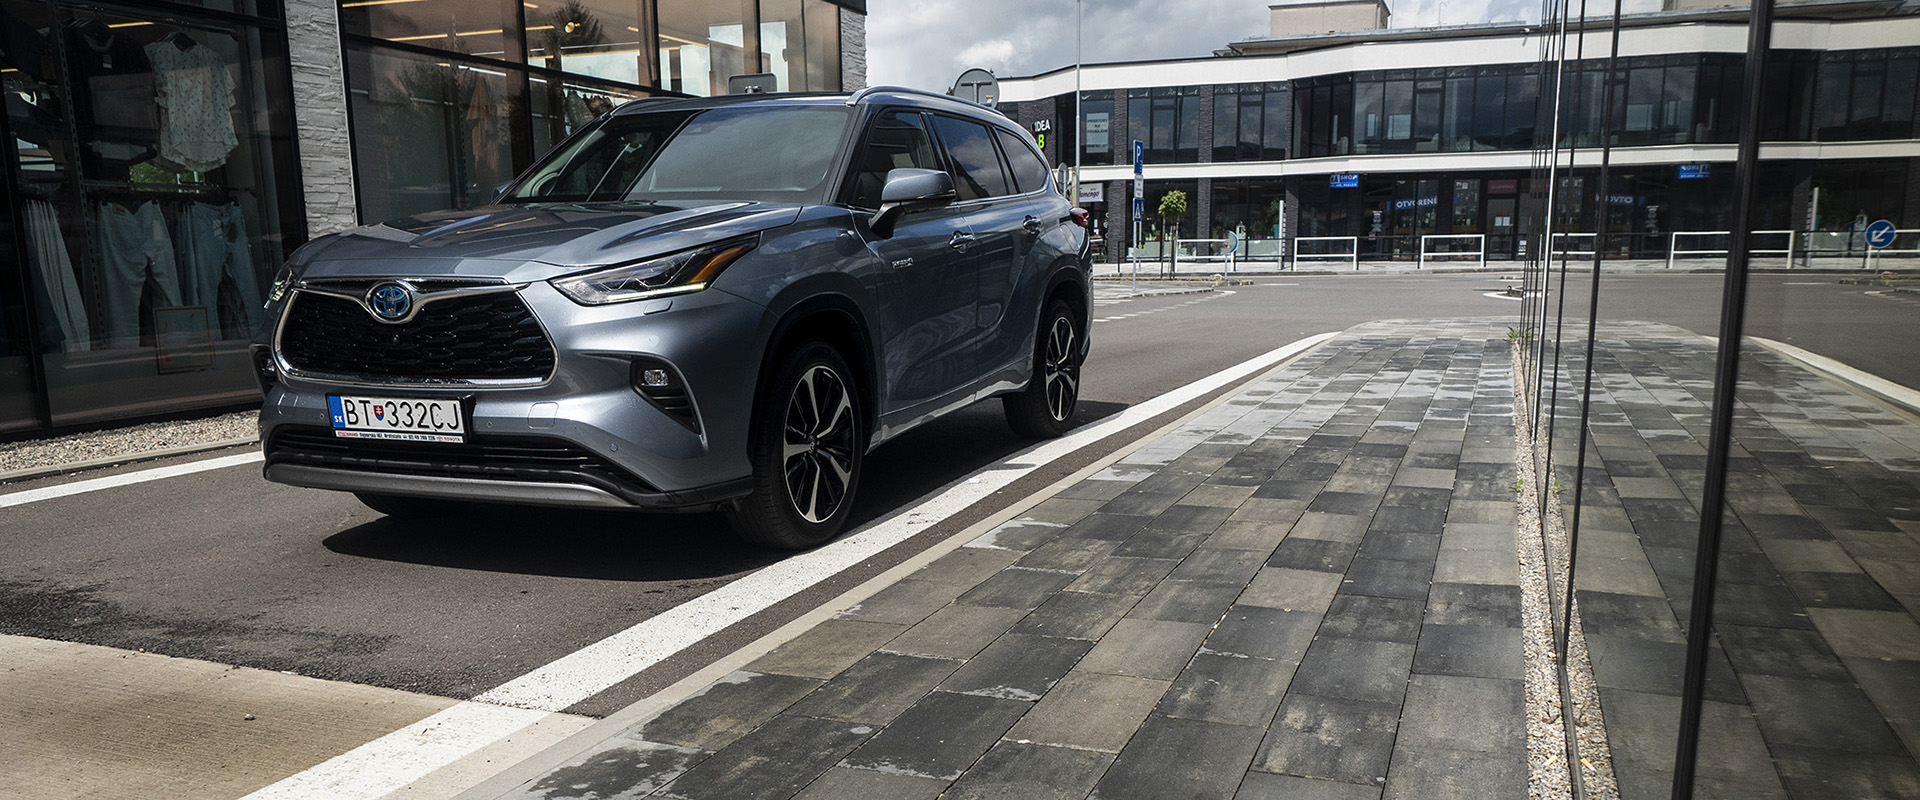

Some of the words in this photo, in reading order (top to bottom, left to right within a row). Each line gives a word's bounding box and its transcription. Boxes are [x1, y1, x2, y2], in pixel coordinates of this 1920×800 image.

[334, 415, 343, 423] SK
[344, 399, 370, 426] BT
[385, 401, 459, 430] 332CJ
